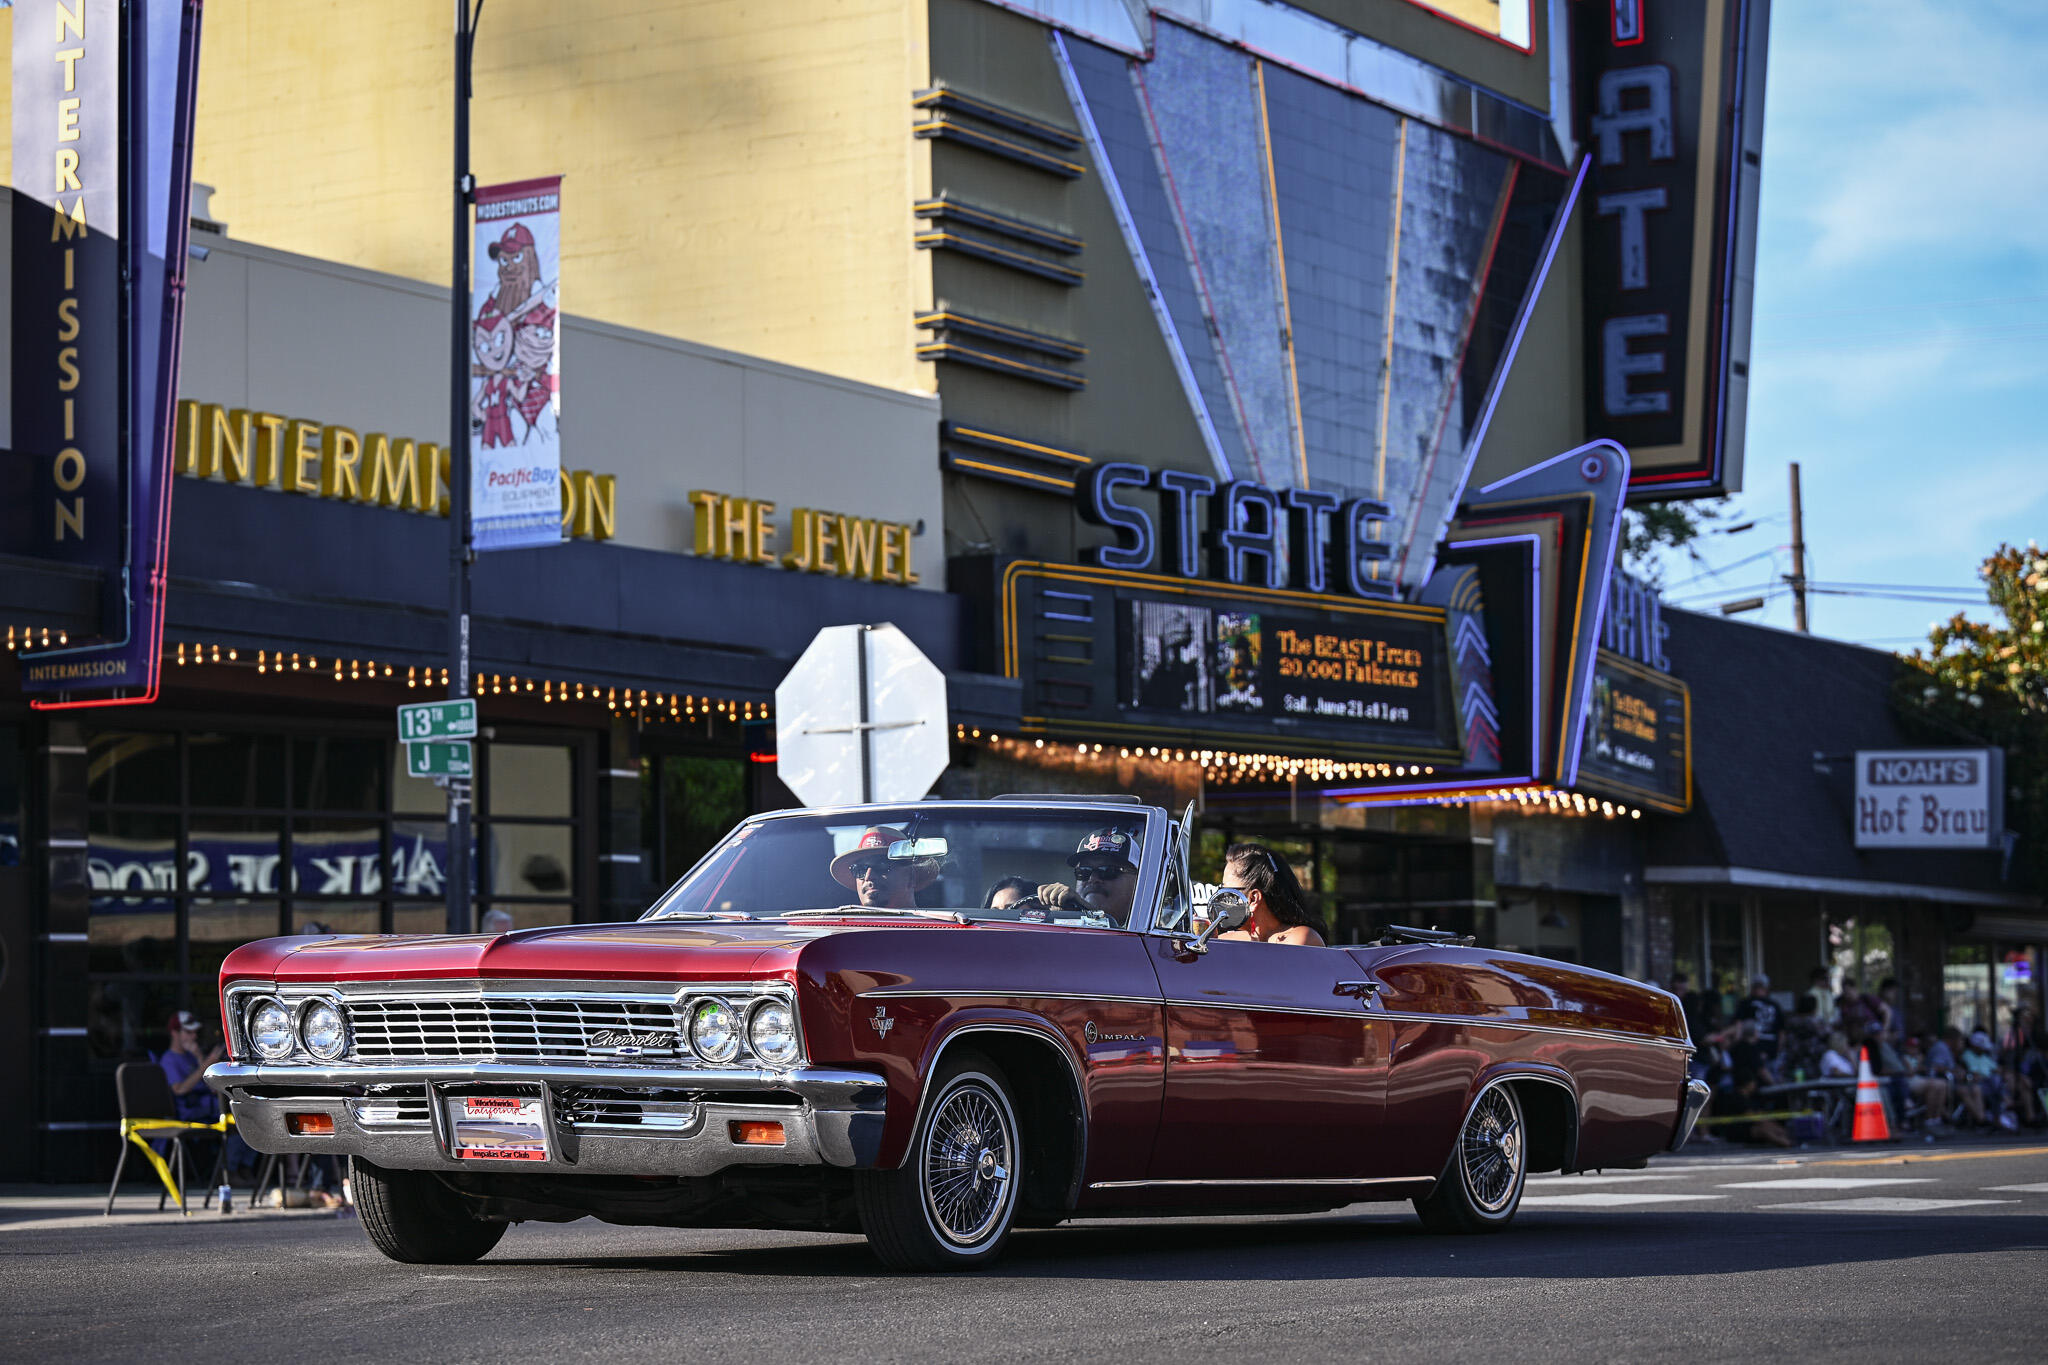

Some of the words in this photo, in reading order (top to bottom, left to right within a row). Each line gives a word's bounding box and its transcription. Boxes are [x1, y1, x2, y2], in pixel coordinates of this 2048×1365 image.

[688, 490, 777, 565] THE
[781, 507, 919, 586] JEWEL
[1085, 461, 1402, 601] STATE
[1276, 629, 1313, 657] The
[1314, 634, 1373, 662] BEAST
[29, 660, 127, 681] INTERMISSION
[1279, 656, 1343, 681] 20,000
[1344, 660, 1419, 689] Fathoms
[1314, 696, 1347, 717] June
[418, 744, 431, 771] J
[1874, 759, 1971, 783] NOAH'S
[1858, 794, 1911, 835] Hof
[1920, 793, 1987, 835] Brau
[590, 1029, 669, 1047] Chevrolet
[1099, 1033, 1146, 1041] IMPALA
[473, 1099, 515, 1108] Worldwide
[472, 1149, 499, 1159] Impalas
[500, 1150, 512, 1158] Car
[513, 1150, 530, 1159] Club
